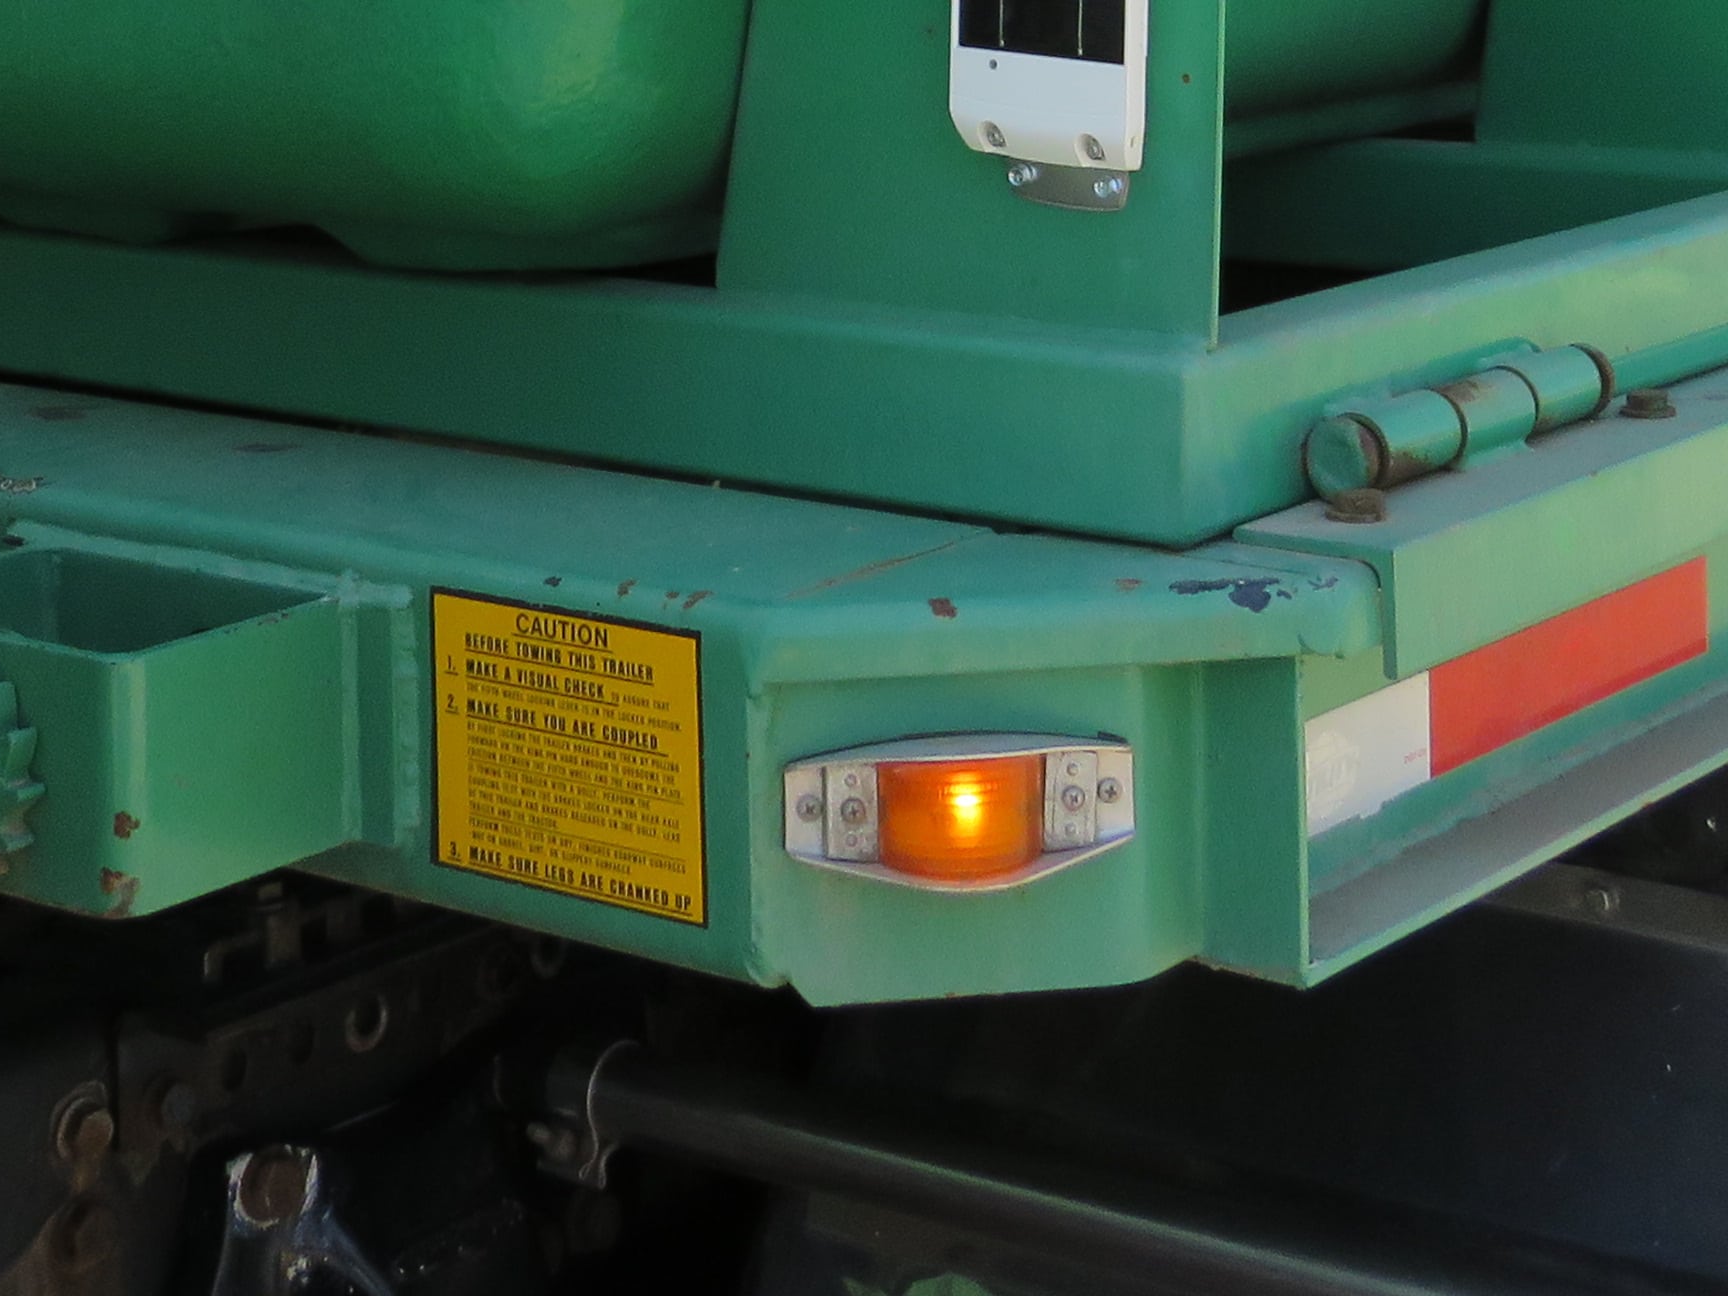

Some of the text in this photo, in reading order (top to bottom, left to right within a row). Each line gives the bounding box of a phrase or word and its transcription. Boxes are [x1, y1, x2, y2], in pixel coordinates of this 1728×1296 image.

[515, 612, 608, 649] CAUTION
[465, 631, 654, 681] BEFORE TOWING THIS TRAILER
[465, 657, 498, 679] MAKE
[503, 664, 511, 682] A
[517, 667, 559, 691] VISUAL
[564, 676, 604, 699] CHECK
[466, 696, 499, 719] MAKE
[505, 704, 535, 726] SURE
[543, 712, 565, 732] YOU
[572, 717, 595, 738] ARE
[602, 723, 658, 751] COUPLED
[469, 845, 502, 867] MAKE
[508, 854, 538, 875] SURE
[544, 862, 573, 883] LEGS
[580, 871, 603, 890] ARE
[609, 877, 669, 906] CRANKED
[674, 892, 691, 911] UP
